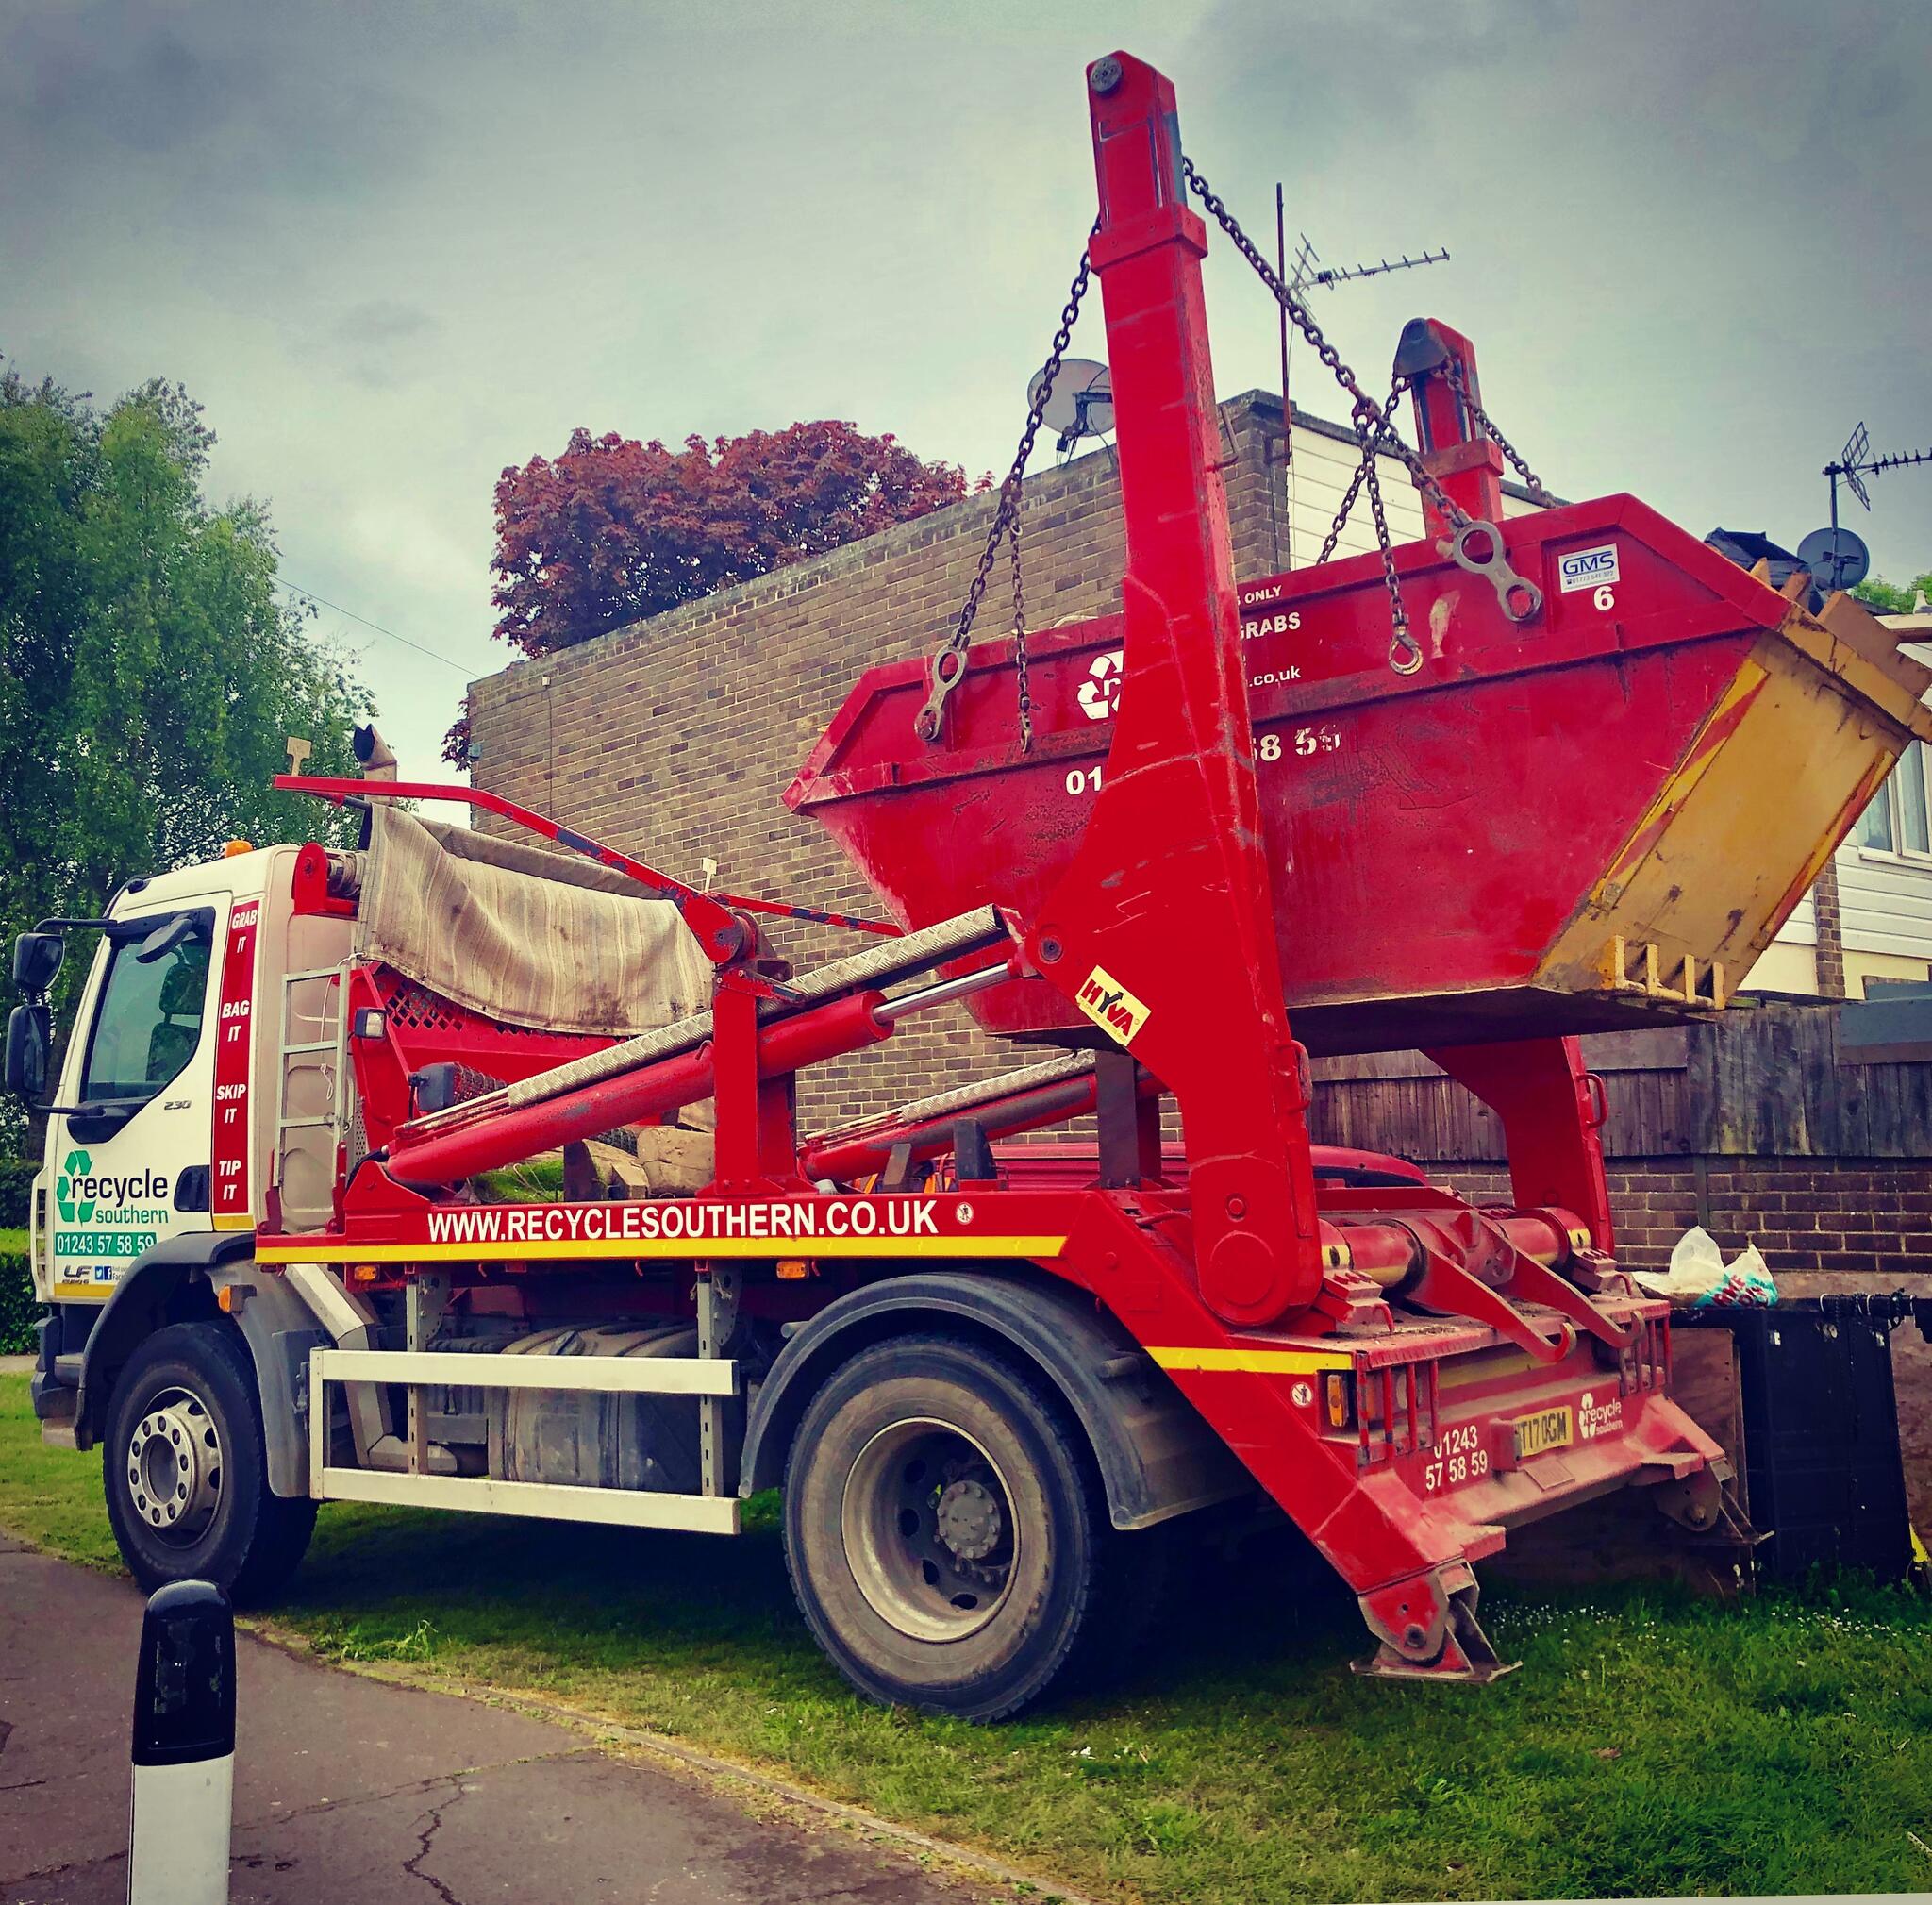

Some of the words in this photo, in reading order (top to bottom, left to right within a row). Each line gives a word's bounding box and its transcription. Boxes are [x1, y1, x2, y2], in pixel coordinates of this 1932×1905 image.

[1562, 550, 1615, 577] GMS
[1244, 585, 1282, 604] ONLY
[1593, 585, 1615, 611] 6
[1246, 665, 1301, 687] .co.uk
[231, 909, 258, 930] GRAB
[236, 936, 247, 954] IT
[222, 1000, 250, 1019] BAG
[1080, 978, 1134, 1037] HYVA
[227, 1025, 242, 1042] IT
[216, 1083, 246, 1101] SKIP
[163, 1100, 192, 1111] 230
[224, 1108, 237, 1124] IT
[219, 1160, 242, 1177] TIP
[72, 1168, 168, 1208] recycle
[223, 1184, 237, 1200] IT
[96, 1204, 168, 1224] southern
[427, 1199, 940, 1243] WWW.RECYCLESOUTHERN.CO.UK
[58, 1234, 93, 1254] 01243
[97, 1235, 112, 1254] 57
[116, 1235, 133, 1254] 58
[63, 1264, 92, 1278] LF
[1584, 1397, 1622, 1424] recycle
[1425, 1462, 1443, 1490] 57
[1449, 1456, 1467, 1482] 58
[1471, 1449, 1488, 1476] 59
